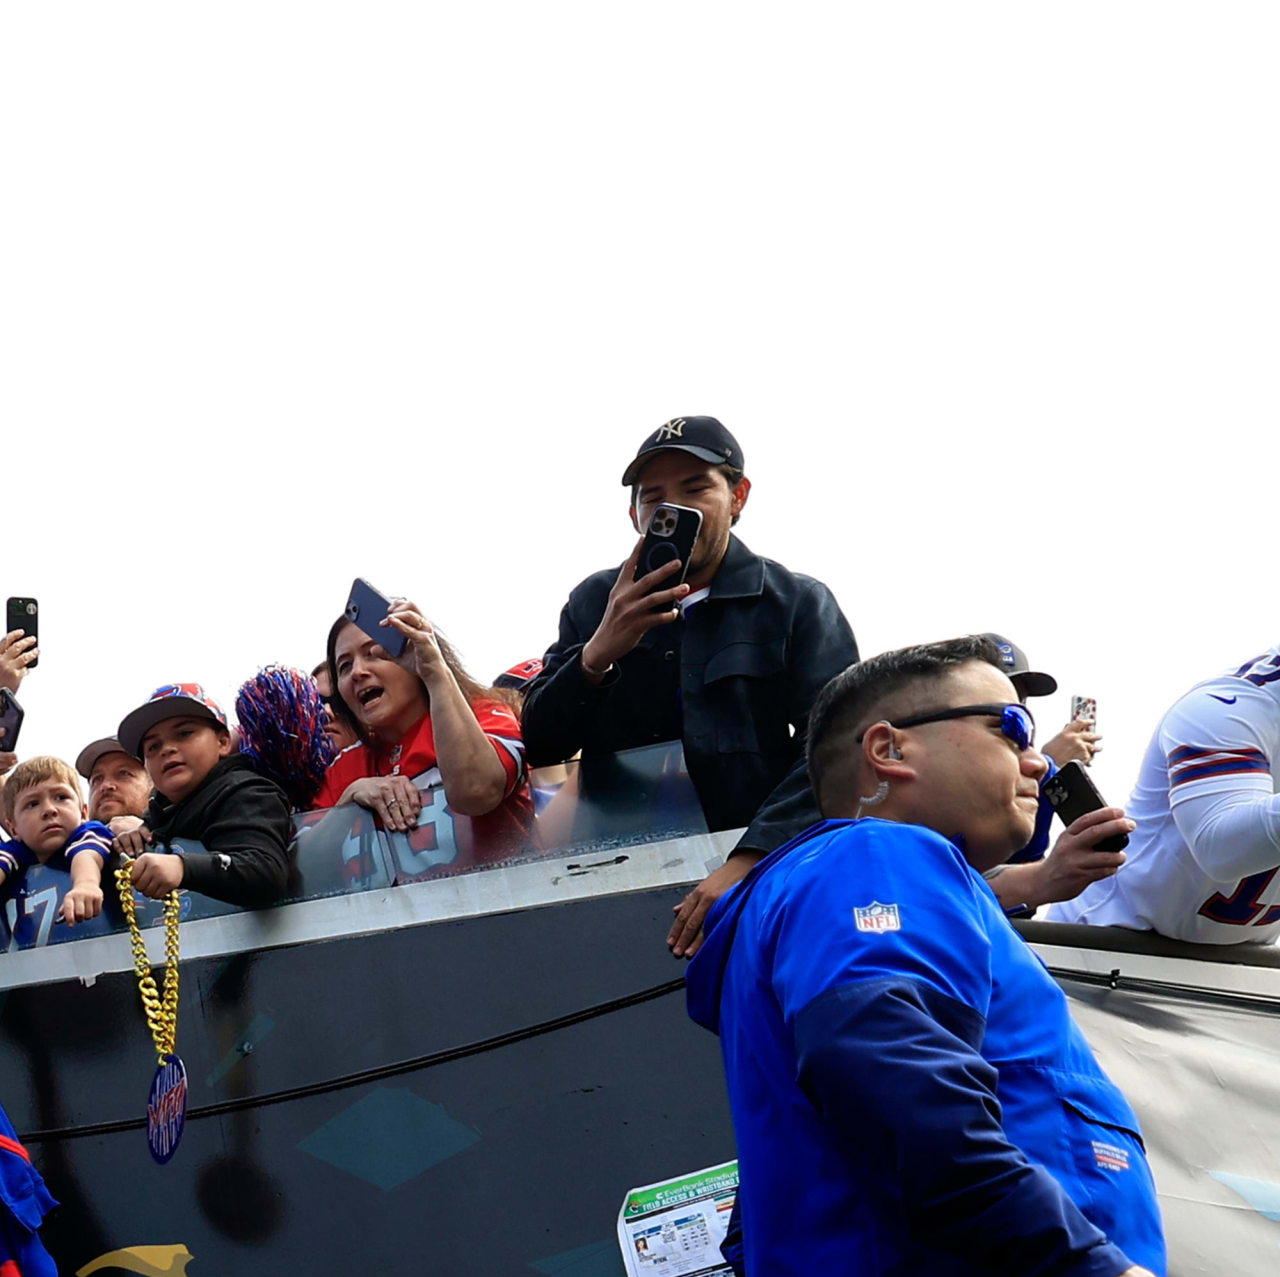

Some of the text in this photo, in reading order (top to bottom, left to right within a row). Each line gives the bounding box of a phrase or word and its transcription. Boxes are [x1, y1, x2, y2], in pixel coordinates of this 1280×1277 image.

[863, 915, 895, 928] NFL
[643, 1202, 661, 1212] FIELD
[662, 1192, 687, 1204] ACCESS
